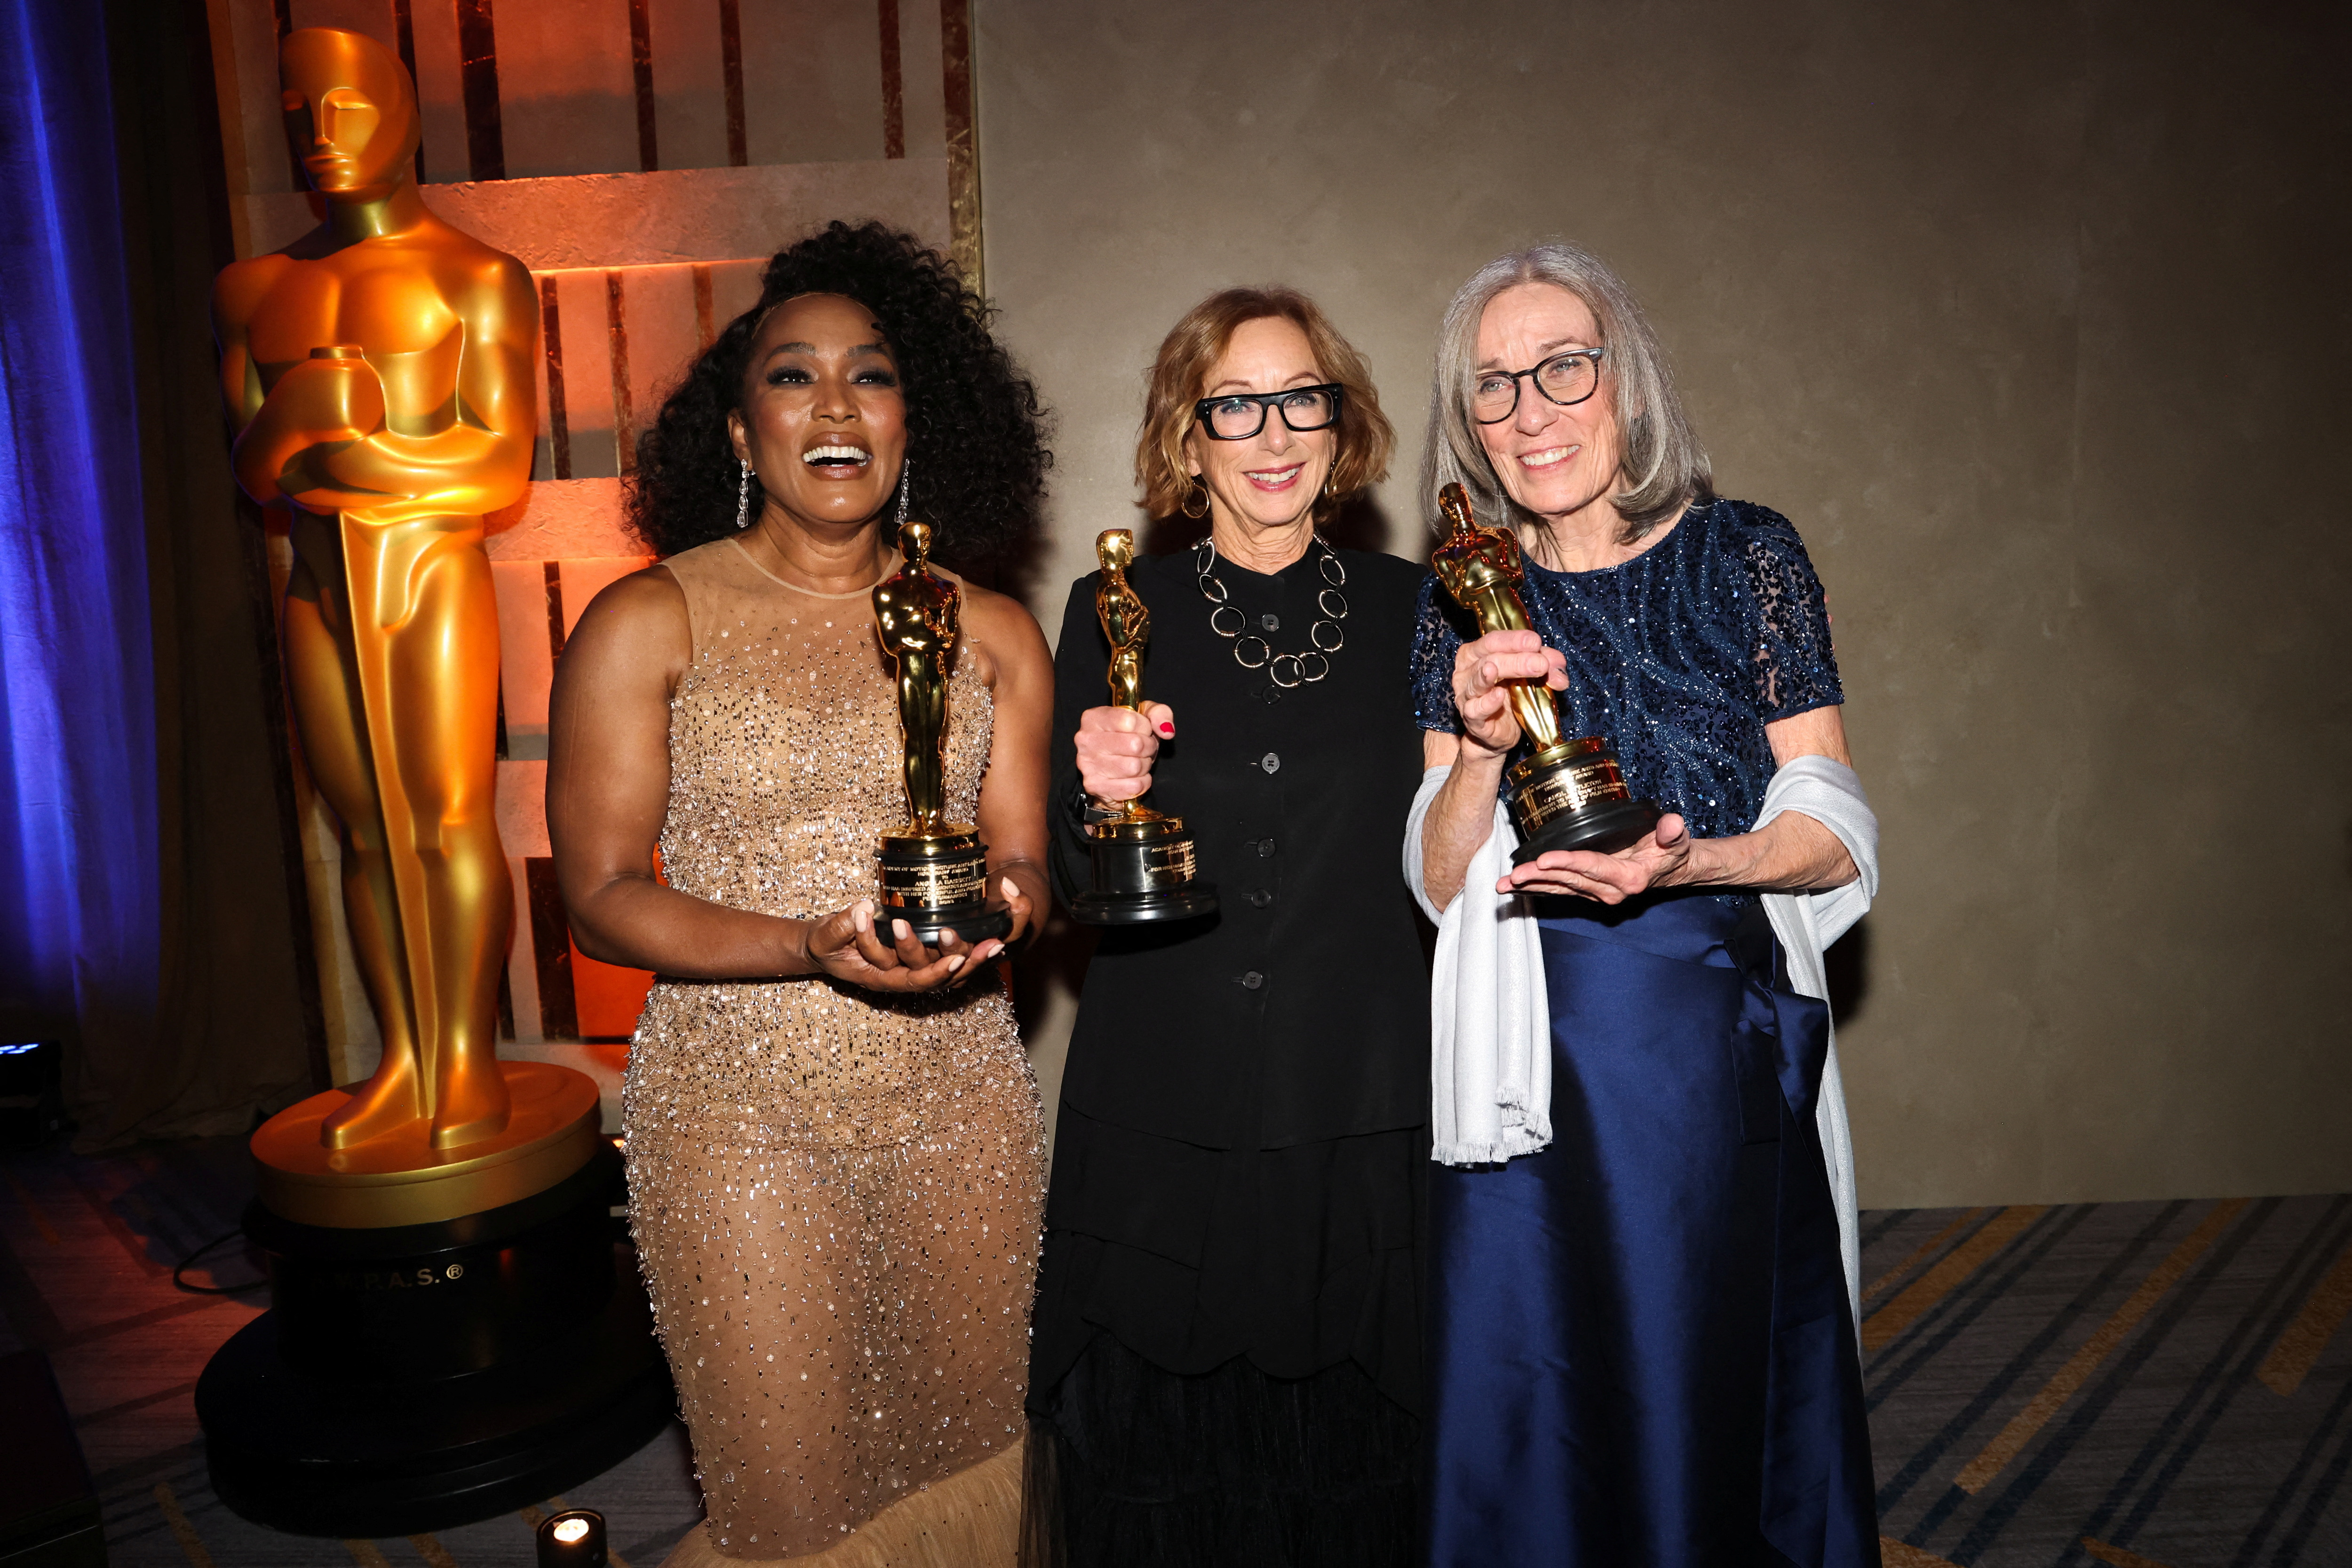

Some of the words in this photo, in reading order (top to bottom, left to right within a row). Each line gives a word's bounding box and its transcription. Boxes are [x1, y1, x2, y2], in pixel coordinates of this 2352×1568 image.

[1544, 776, 1574, 792] HONORY
[1575, 771, 1594, 780] AWARD
[1556, 768, 1581, 783] PIURE
[1544, 791, 1566, 803] CAROL
[1565, 779, 1602, 796] LTTLETON
[945, 876, 971, 885] BASSETT
[922, 892, 968, 902] PEORMANCES
